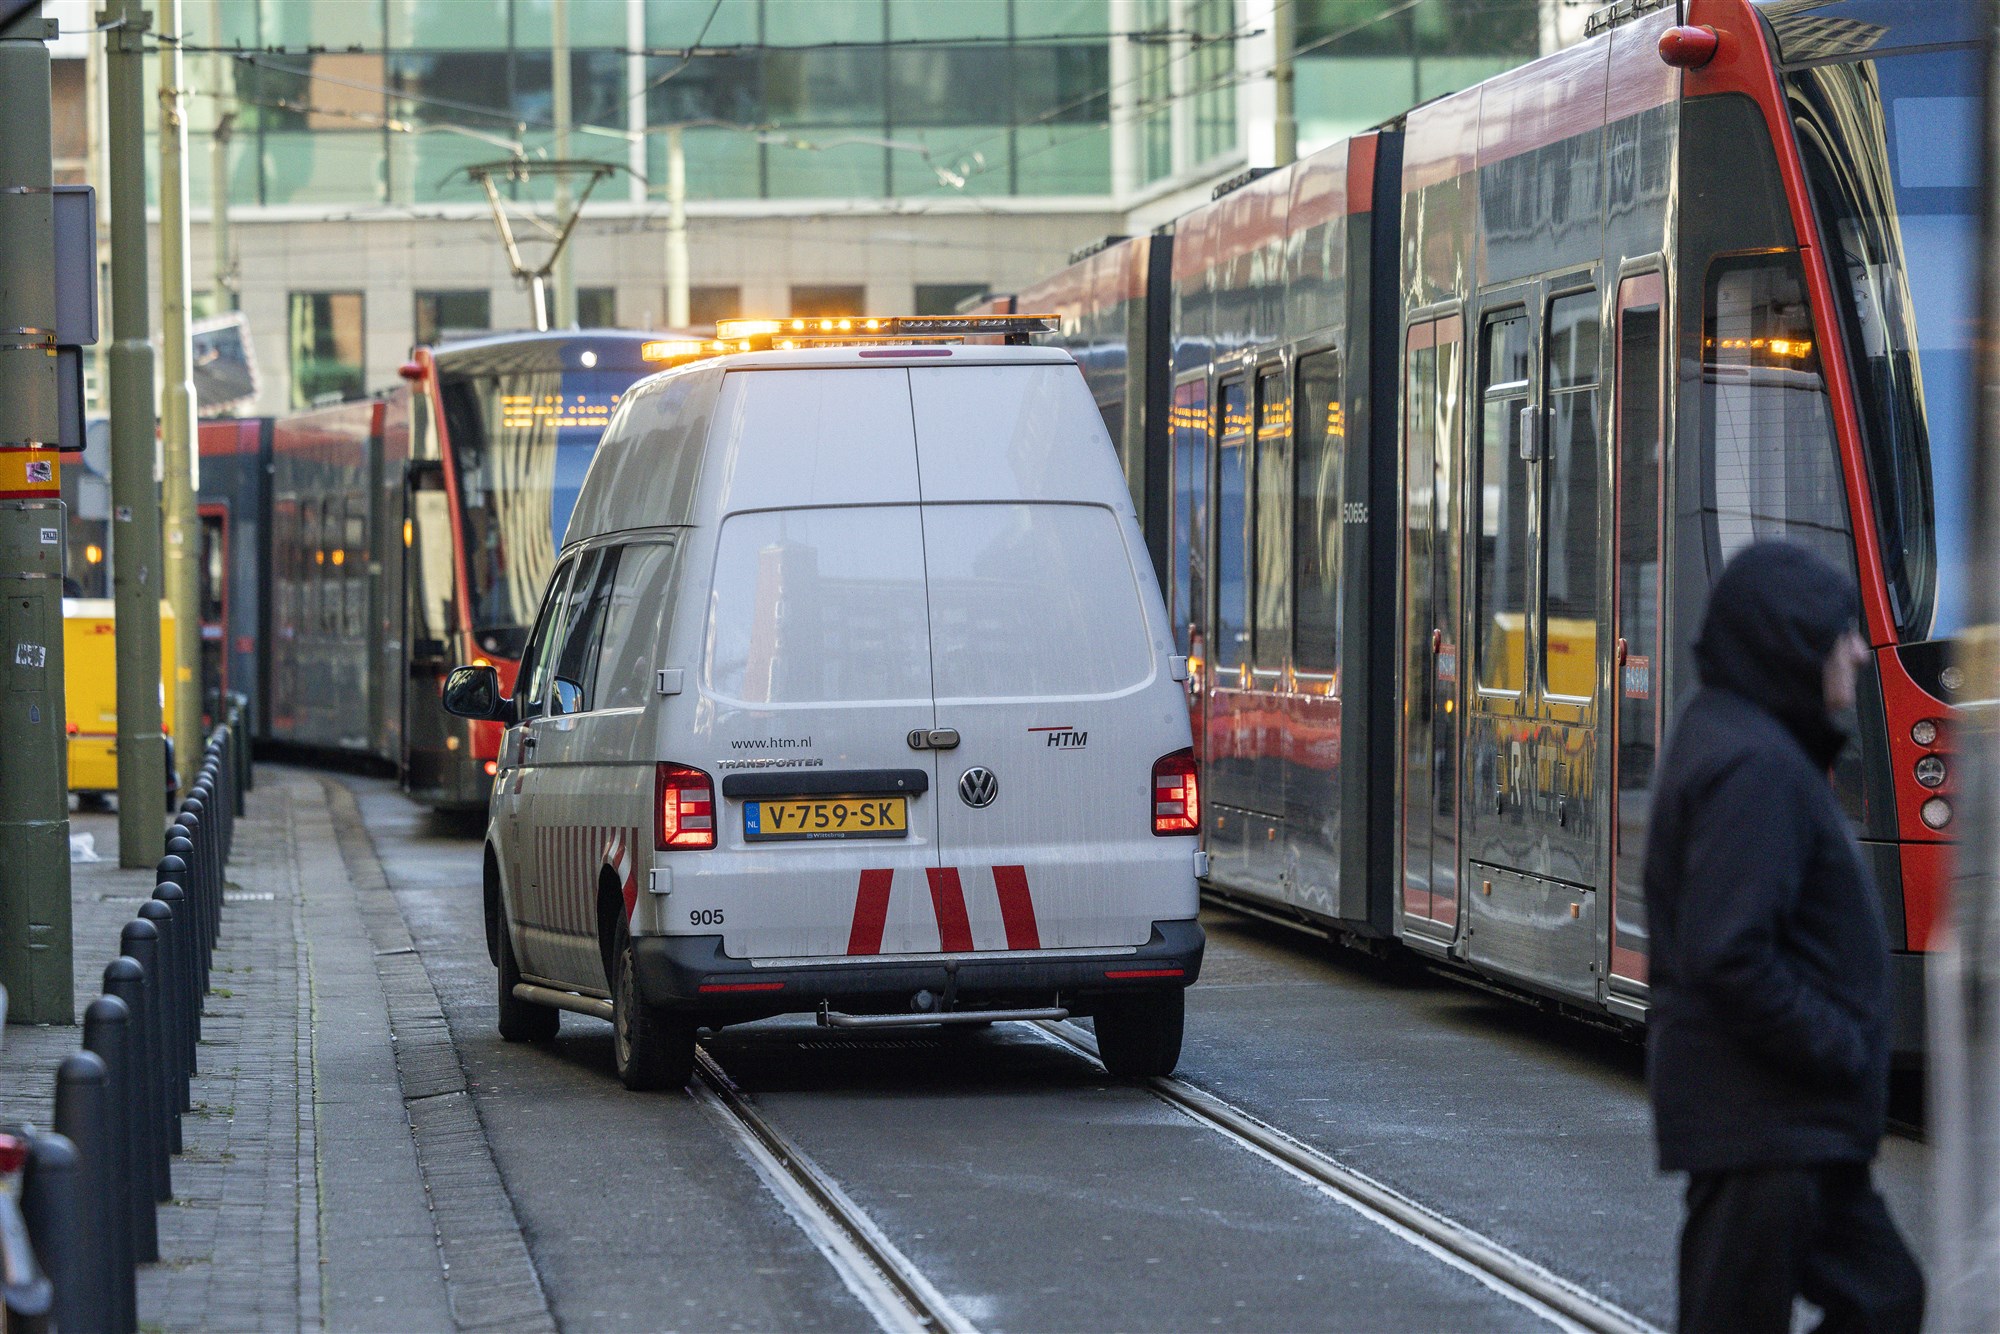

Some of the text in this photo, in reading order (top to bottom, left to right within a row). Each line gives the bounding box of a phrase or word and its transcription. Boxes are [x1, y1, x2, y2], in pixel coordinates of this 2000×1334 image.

[1343, 502, 1369, 524] 5065c
[731, 736, 812, 749] www.htm.nl
[1047, 732, 1088, 747] HTM
[716, 758, 824, 769] TRANSPORTER
[768, 802, 895, 829] V-759-SK
[747, 820, 758, 828] NL
[690, 909, 725, 926] 905
